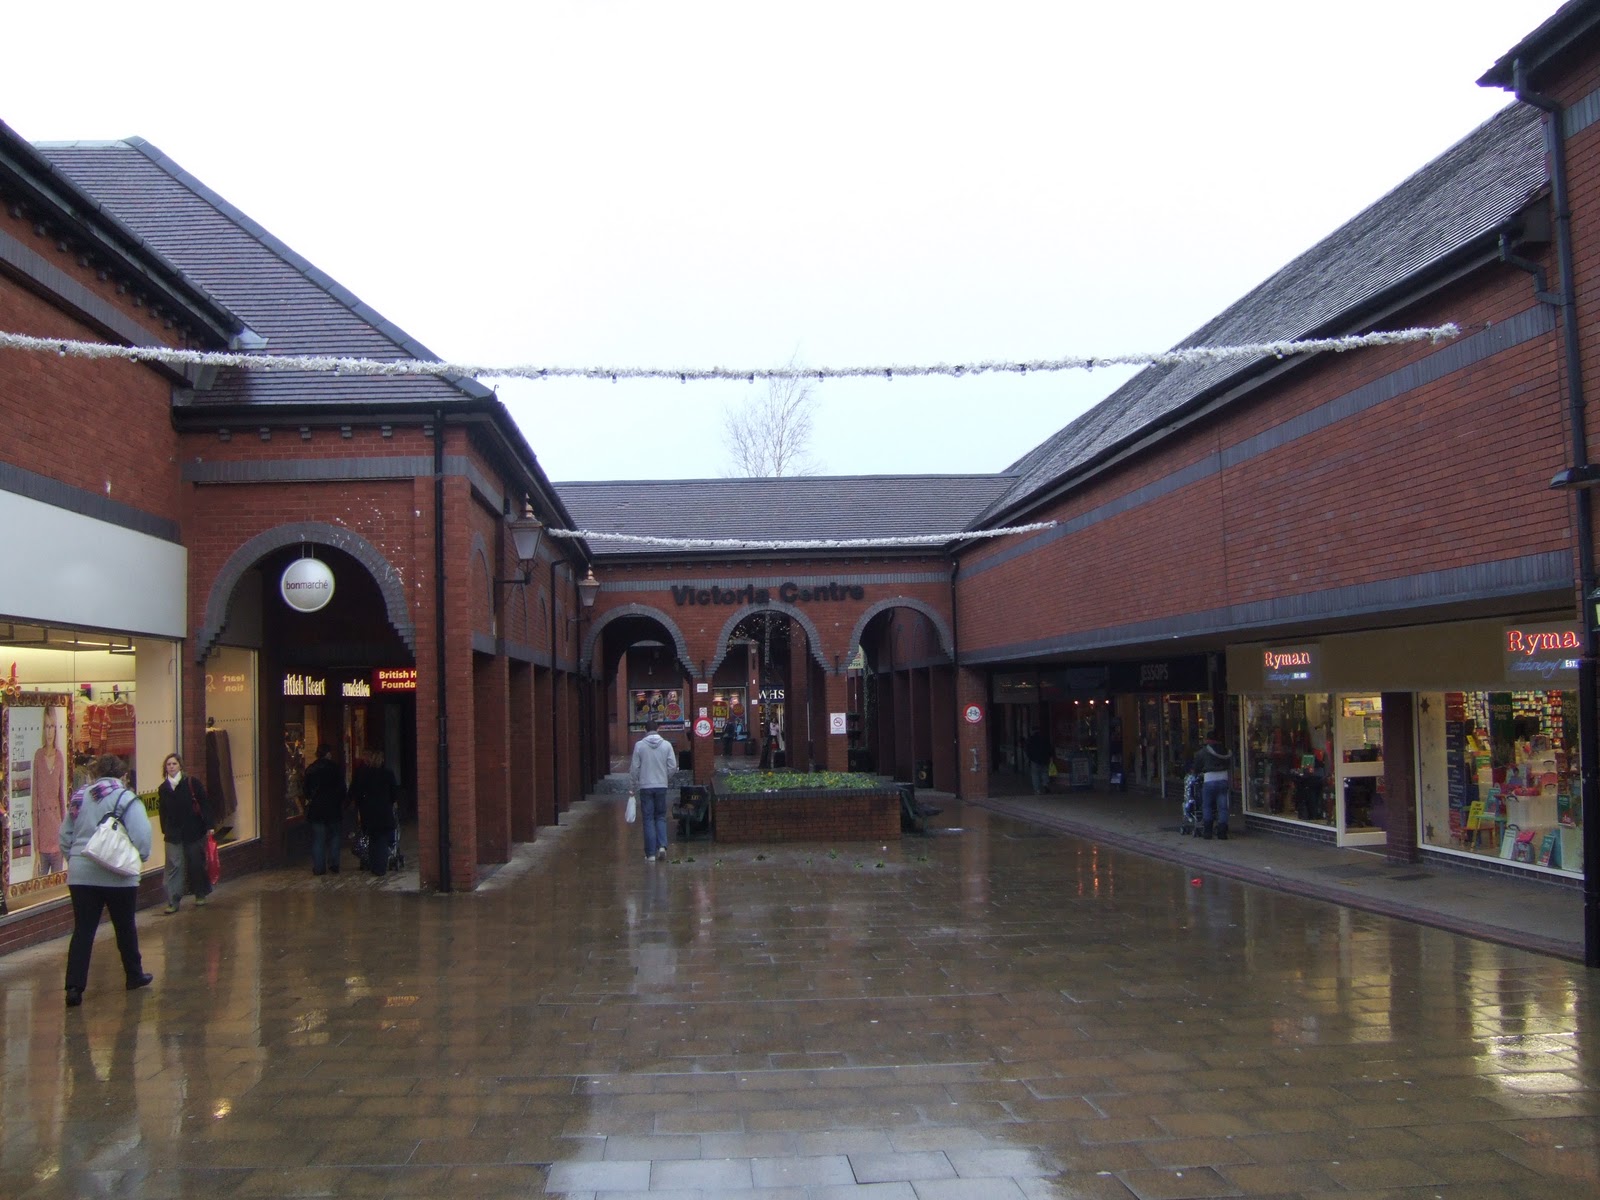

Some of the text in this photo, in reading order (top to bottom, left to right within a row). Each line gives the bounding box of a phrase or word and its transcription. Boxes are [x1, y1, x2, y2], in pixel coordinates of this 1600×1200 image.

[286, 580, 328, 590] bonmarché
[671, 582, 864, 606] Victoria Centre
[1506, 630, 1580, 656] Ryma
[1264, 651, 1311, 670] Ryman
[305, 675, 326, 696] Heart
[378, 671, 409, 680] British
